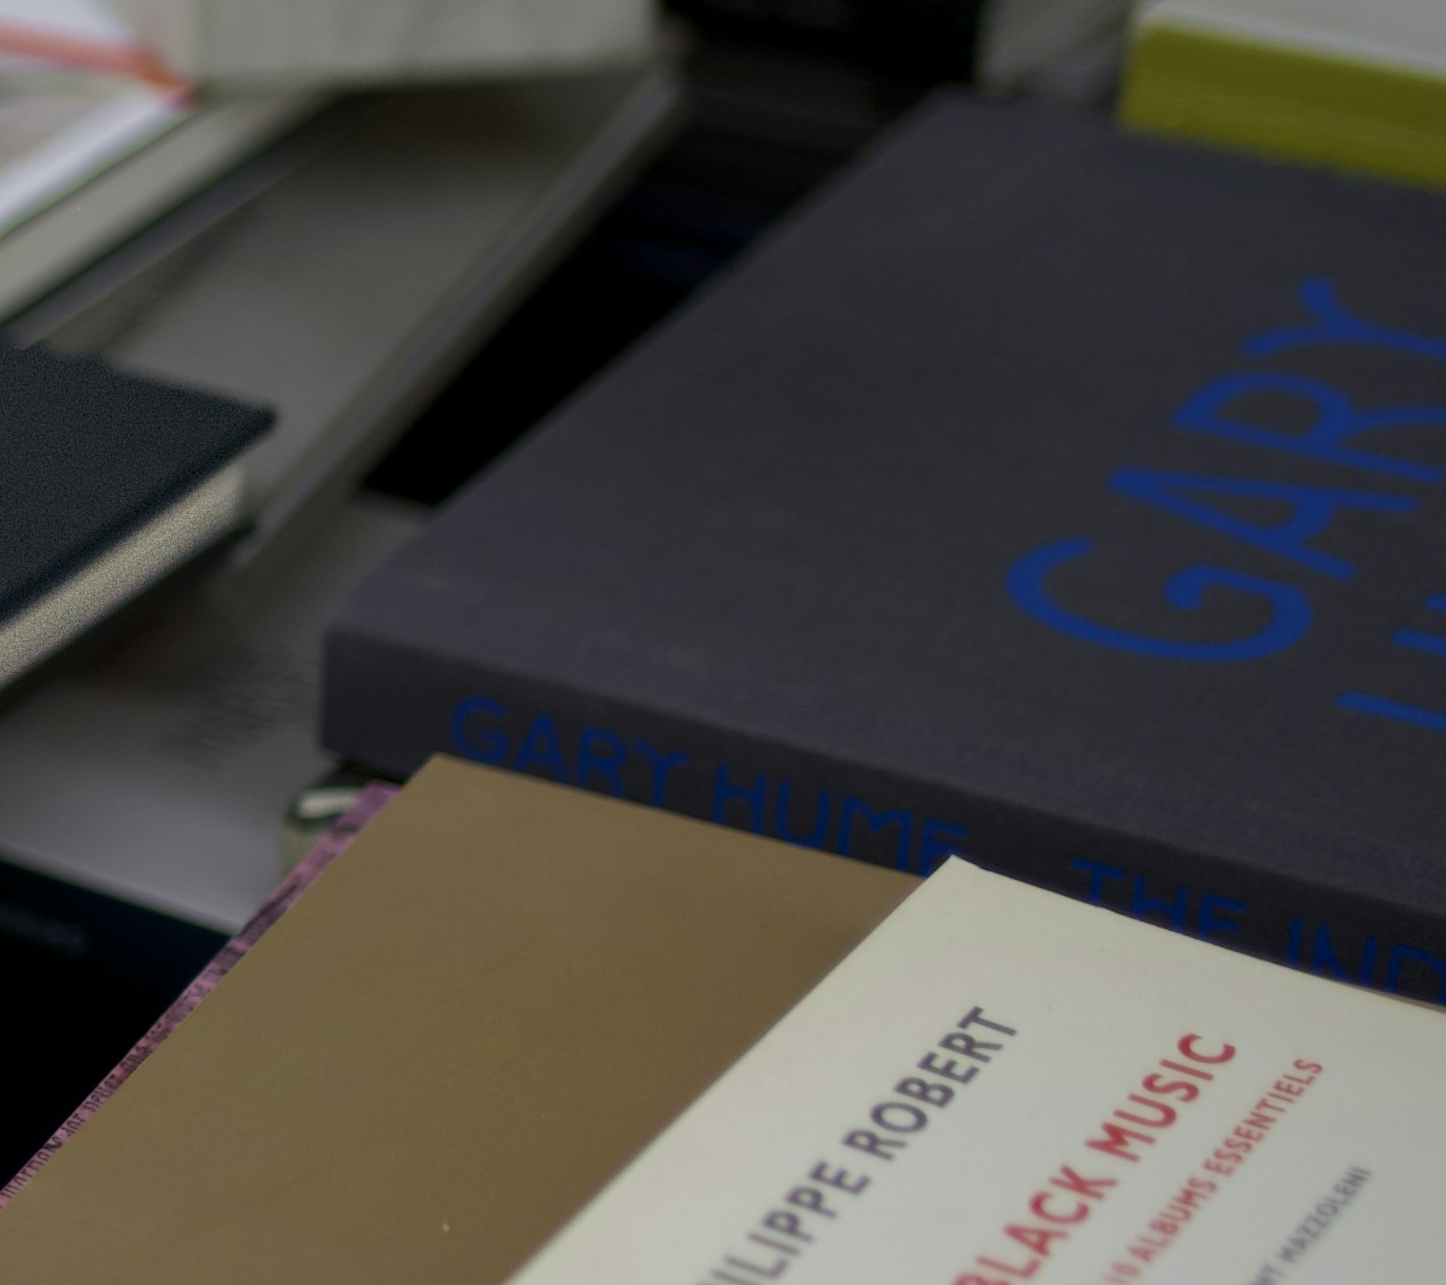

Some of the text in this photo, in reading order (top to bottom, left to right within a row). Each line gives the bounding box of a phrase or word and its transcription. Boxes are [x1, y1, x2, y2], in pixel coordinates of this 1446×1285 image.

[1004, 274, 1446, 664] GARY
[448, 696, 690, 806] GARY
[853, 1004, 1019, 1162] ROBERT
[1084, 1032, 1238, 1164] MUSIC
[1126, 1174, 1220, 1270] ALBUMS
[1203, 1056, 1325, 1179] ESSENTIELS
[1277, 1163, 1372, 1268] MAZZOLENI
